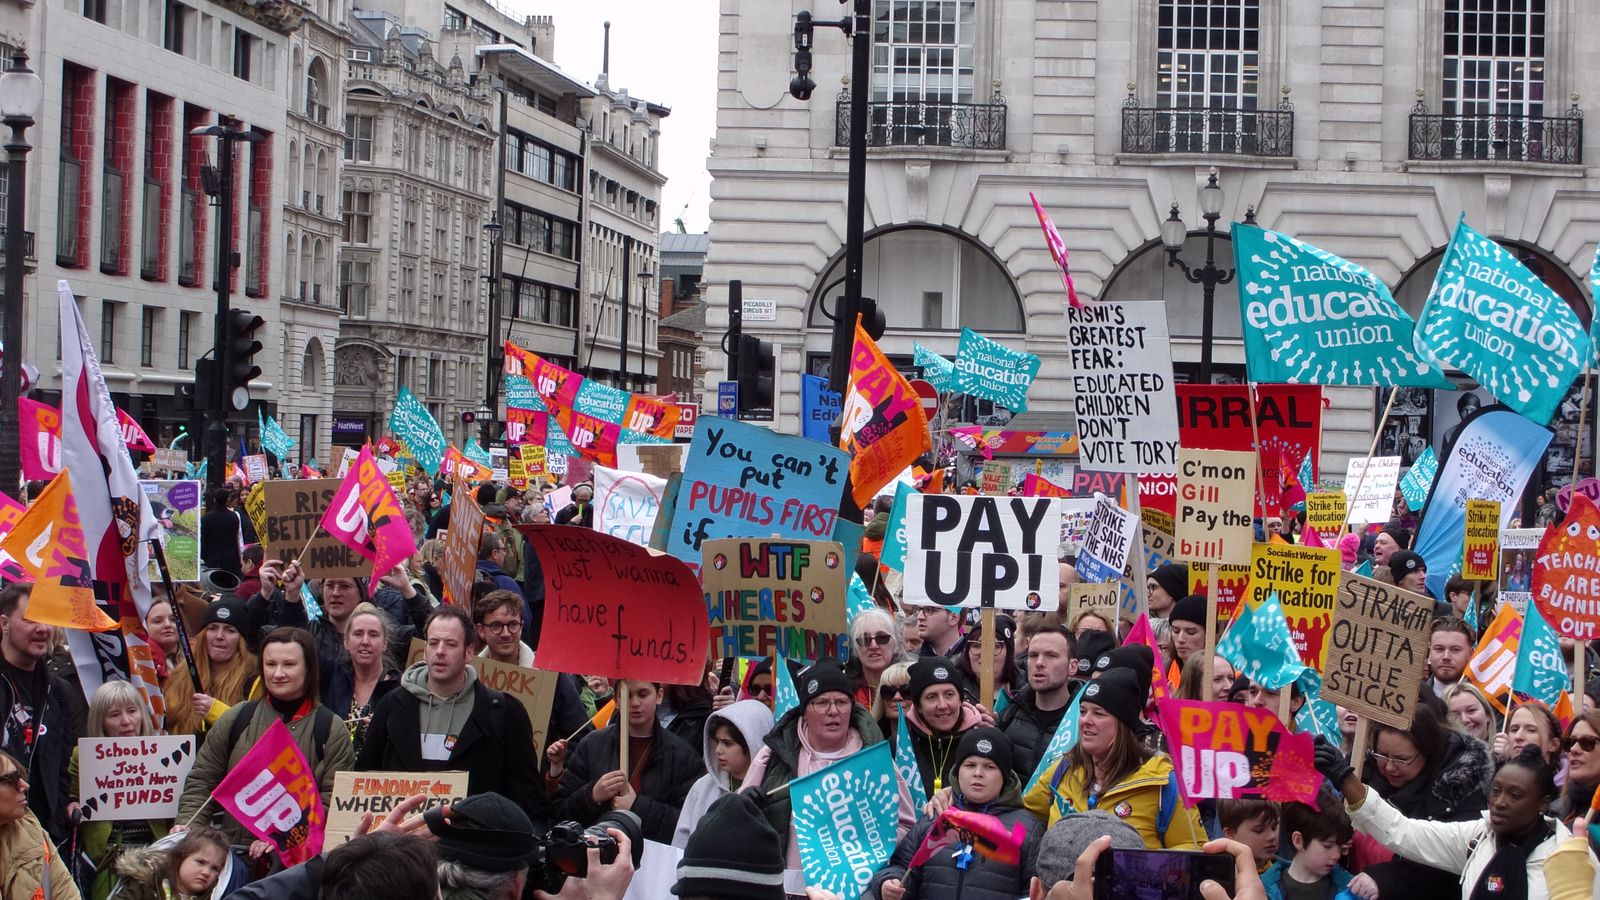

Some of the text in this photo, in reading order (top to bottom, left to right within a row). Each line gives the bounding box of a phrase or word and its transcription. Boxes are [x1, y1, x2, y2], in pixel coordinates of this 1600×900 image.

[1292, 263, 1376, 292] nationa
[1466, 258, 1552, 314] national
[1068, 305, 1125, 324] RISHI'S
[1246, 285, 1400, 329] educati
[1440, 275, 1579, 367] ducation
[1069, 326, 1146, 349] GREATEST
[1315, 323, 1393, 349] union
[1464, 321, 1516, 361] union
[977, 351, 1018, 369] national
[1071, 349, 1124, 370] FEAR:
[541, 366, 570, 384] PAY
[852, 339, 916, 423] PAY
[955, 358, 1031, 386] education
[1074, 373, 1164, 393] EDUCATED
[538, 375, 556, 397] UP
[591, 392, 614, 402] national
[979, 377, 1009, 394] union
[577, 396, 624, 411] education
[1075, 395, 1150, 417] CHILDREN
[1177, 396, 1313, 429] IRRAL
[338, 422, 364, 430] NatWest
[394, 404, 440, 449] educatio
[407, 411, 438, 434] national
[508, 411, 535, 423] PAY
[576, 414, 605, 433] PAY
[629, 411, 654, 433] UP
[1078, 417, 1130, 440] DON'T
[507, 422, 526, 442] UP
[572, 426, 594, 448] UP
[676, 427, 693, 435] VAPE
[706, 428, 839, 485] You can't
[1081, 441, 1126, 465] VOTE
[1131, 440, 1179, 465] TORY
[1478, 450, 1509, 475] national
[740, 465, 785, 489] put
[1183, 460, 1245, 480] C'mon
[1459, 447, 1514, 498] education
[1475, 470, 1496, 488] union
[1074, 473, 1120, 493] PAY
[1138, 482, 1178, 495] NION
[1182, 483, 1219, 503] Gill
[296, 489, 335, 513] RIS
[689, 480, 839, 537] PUPILS FIRST
[1309, 500, 1345, 511] Strike for
[921, 495, 1052, 553] PAY
[1095, 501, 1126, 534] STRIKE
[1142, 513, 1161, 523] Strike
[1182, 506, 1251, 531] Pay the
[1309, 511, 1346, 522] education
[1468, 510, 1499, 524] Strike for
[683, 518, 715, 551] if
[1090, 516, 1100, 536] TO
[1101, 527, 1127, 553] SAVE
[1467, 526, 1498, 538] education
[532, 529, 637, 562] Teachers
[1085, 532, 1100, 555] THE
[1101, 547, 1124, 569] NHS
[1181, 538, 1223, 560] bill!
[1267, 548, 1328, 561] Socialist Worker
[552, 555, 681, 591] just wanna
[740, 543, 810, 581] WTF
[1091, 563, 1100, 572] out
[1255, 557, 1336, 586] Strike for
[925, 551, 1043, 609] UP!
[1565, 575, 1600, 597] ARE
[557, 594, 607, 627] have
[705, 588, 806, 624] WHERE'S
[1080, 590, 1117, 608] FUND
[1340, 579, 1431, 632] STRAIGHT
[611, 605, 696, 670] funds!
[709, 624, 849, 663] THE FUNDING
[1292, 630, 1305, 640] the
[1333, 619, 1413, 665] OUTTA
[480, 662, 536, 696] WORK
[1340, 653, 1402, 688] GLUE
[1327, 670, 1405, 713] STICKS
[1179, 707, 1279, 752] PAY
[95, 740, 158, 760] Schools
[113, 761, 148, 776] Just
[1181, 746, 1251, 799] UP
[95, 772, 177, 790] Wanna Have
[352, 778, 431, 796] FUNDING
[114, 788, 174, 809] FUNDS
[234, 768, 303, 834] UP
[821, 773, 874, 893] educatio
[857, 797, 889, 864] national
[817, 825, 842, 867] union
[1487, 883, 1498, 891] UP
